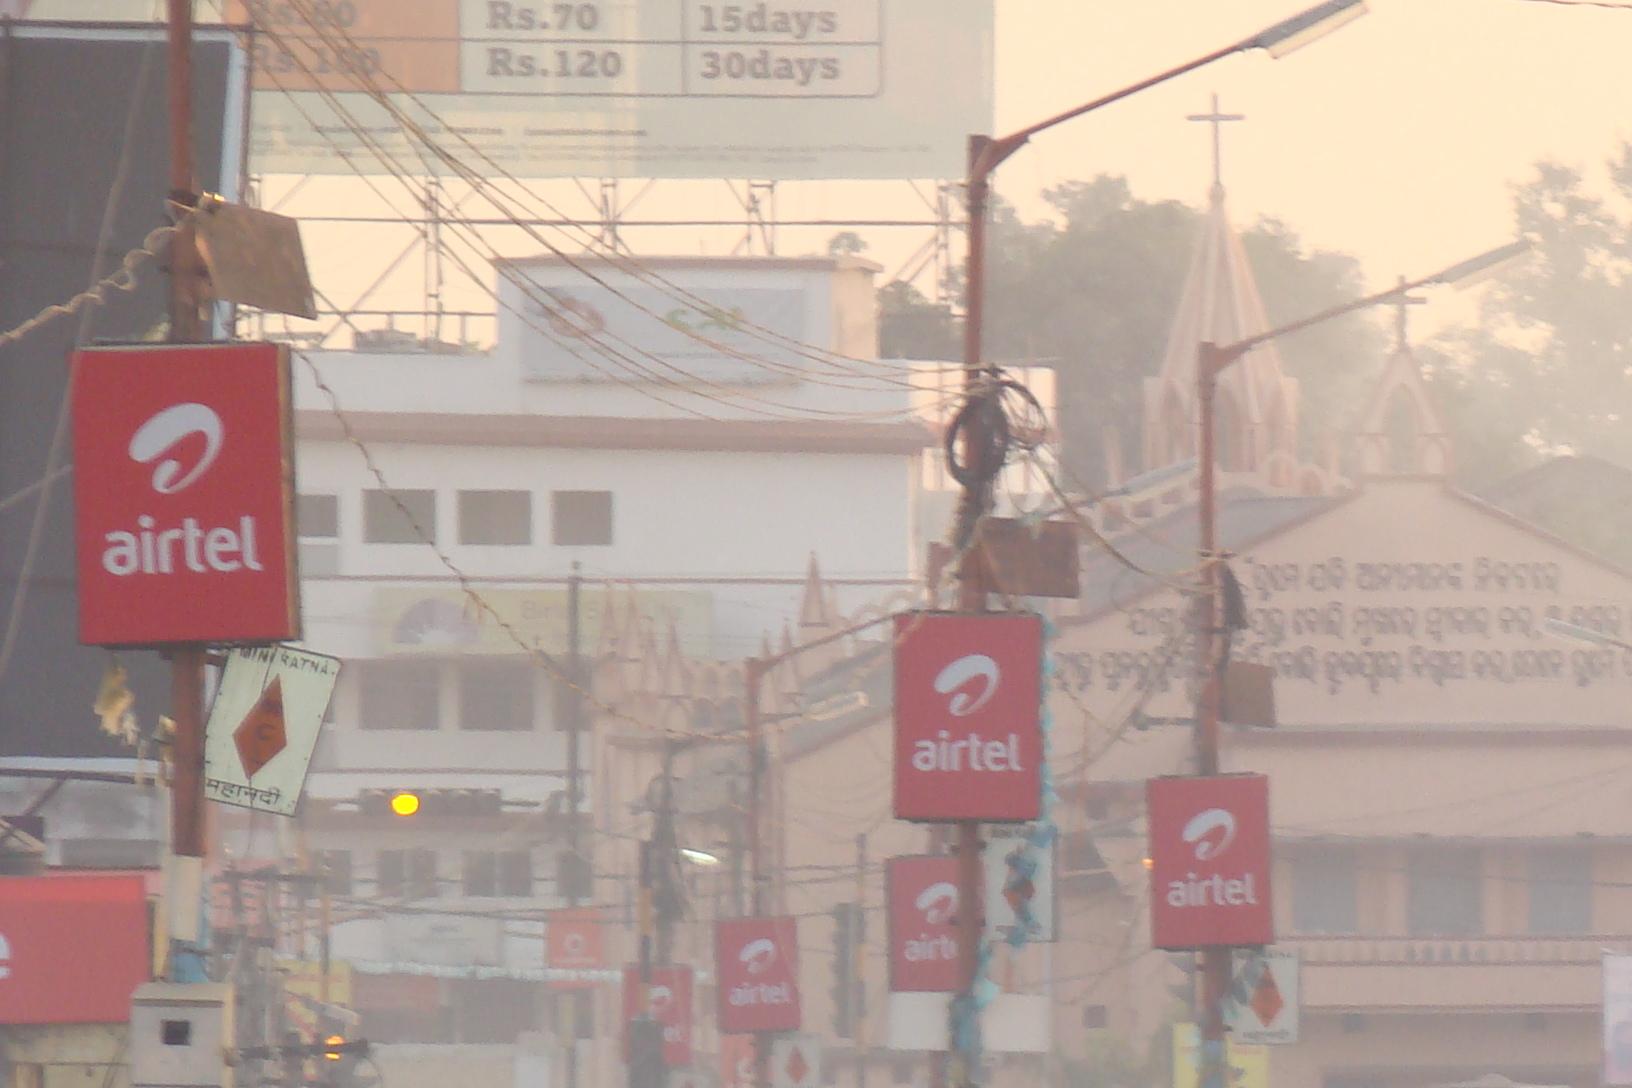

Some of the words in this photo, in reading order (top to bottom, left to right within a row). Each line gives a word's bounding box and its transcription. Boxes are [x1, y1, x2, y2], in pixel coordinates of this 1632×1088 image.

[487, 1, 599, 31] Rs.70
[700, 3, 838, 39] 15days
[487, 48, 622, 78] Rs.120
[700, 49, 840, 86] 30days
[103, 516, 263, 576] airtel
[280, 655, 329, 676] RATNA
[912, 730, 1024, 772] airtel
[1167, 872, 1258, 907] airtel
[729, 982, 791, 1006] airtel
